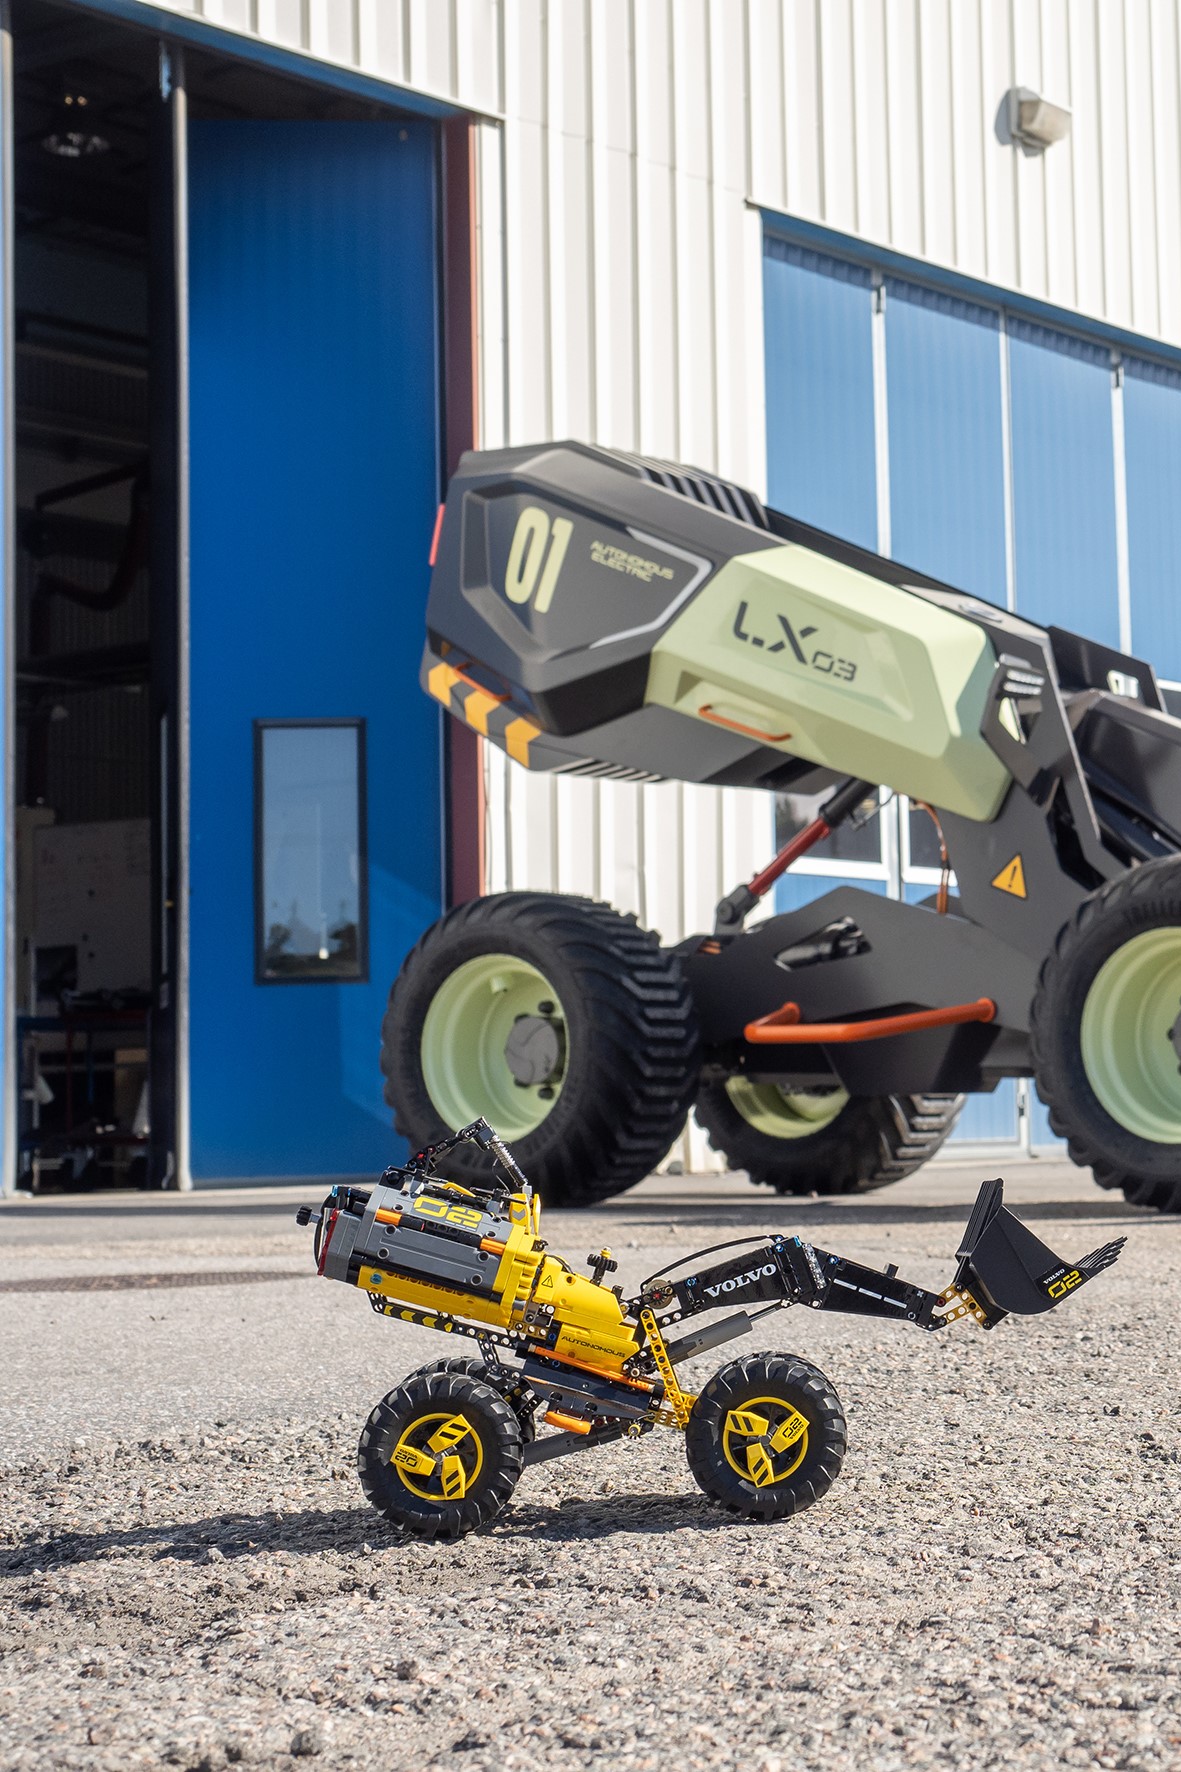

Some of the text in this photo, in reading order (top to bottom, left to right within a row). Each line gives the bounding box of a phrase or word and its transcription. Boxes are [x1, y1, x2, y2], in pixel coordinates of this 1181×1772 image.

[505, 506, 574, 614] 01
[590, 540, 674, 580] AUTONOMOUS
[591, 551, 653, 583] ELECTRIC
[413, 1196, 483, 1229] 02
[703, 1263, 777, 1298] VOLVO
[1043, 1268, 1065, 1284] VOLVO
[1048, 1270, 1082, 1298] 02
[561, 1335, 626, 1358] AUTONOMOUS
[782, 1417, 802, 1438] 02
